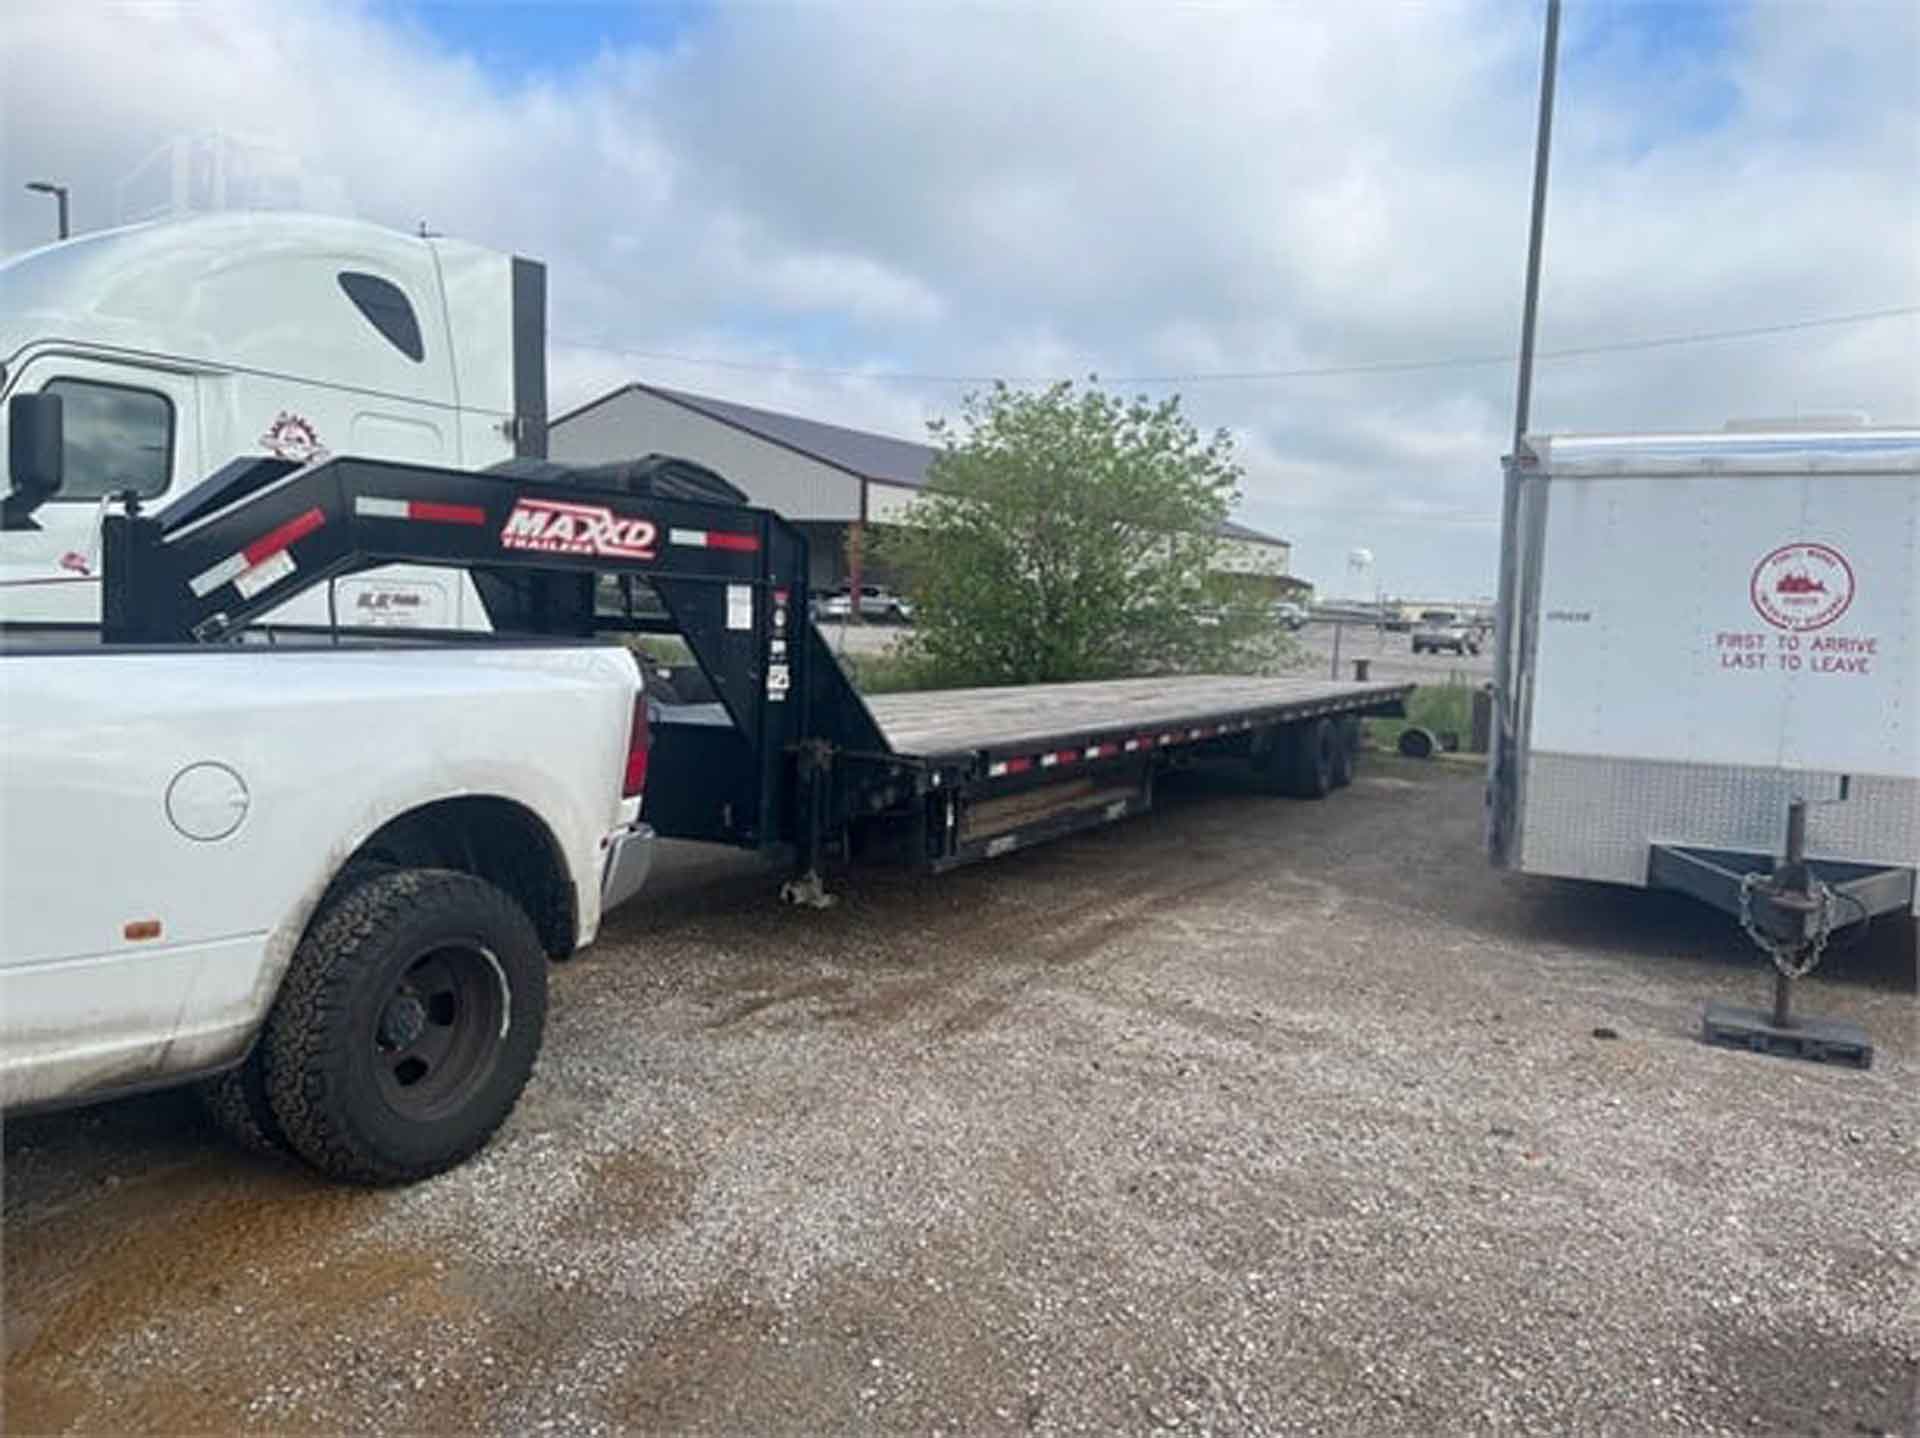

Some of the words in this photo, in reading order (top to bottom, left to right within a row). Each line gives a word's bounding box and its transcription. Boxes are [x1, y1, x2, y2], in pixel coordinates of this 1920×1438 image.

[502, 507, 656, 548] MAXXD
[1716, 633, 1765, 649] FIRST
[1777, 634, 1800, 651] TO
[1810, 635, 1878, 654] ARRIVE
[1721, 653, 1767, 669] LAST
[1780, 653, 1802, 671] TO
[1811, 655, 1870, 673] LEAVE
